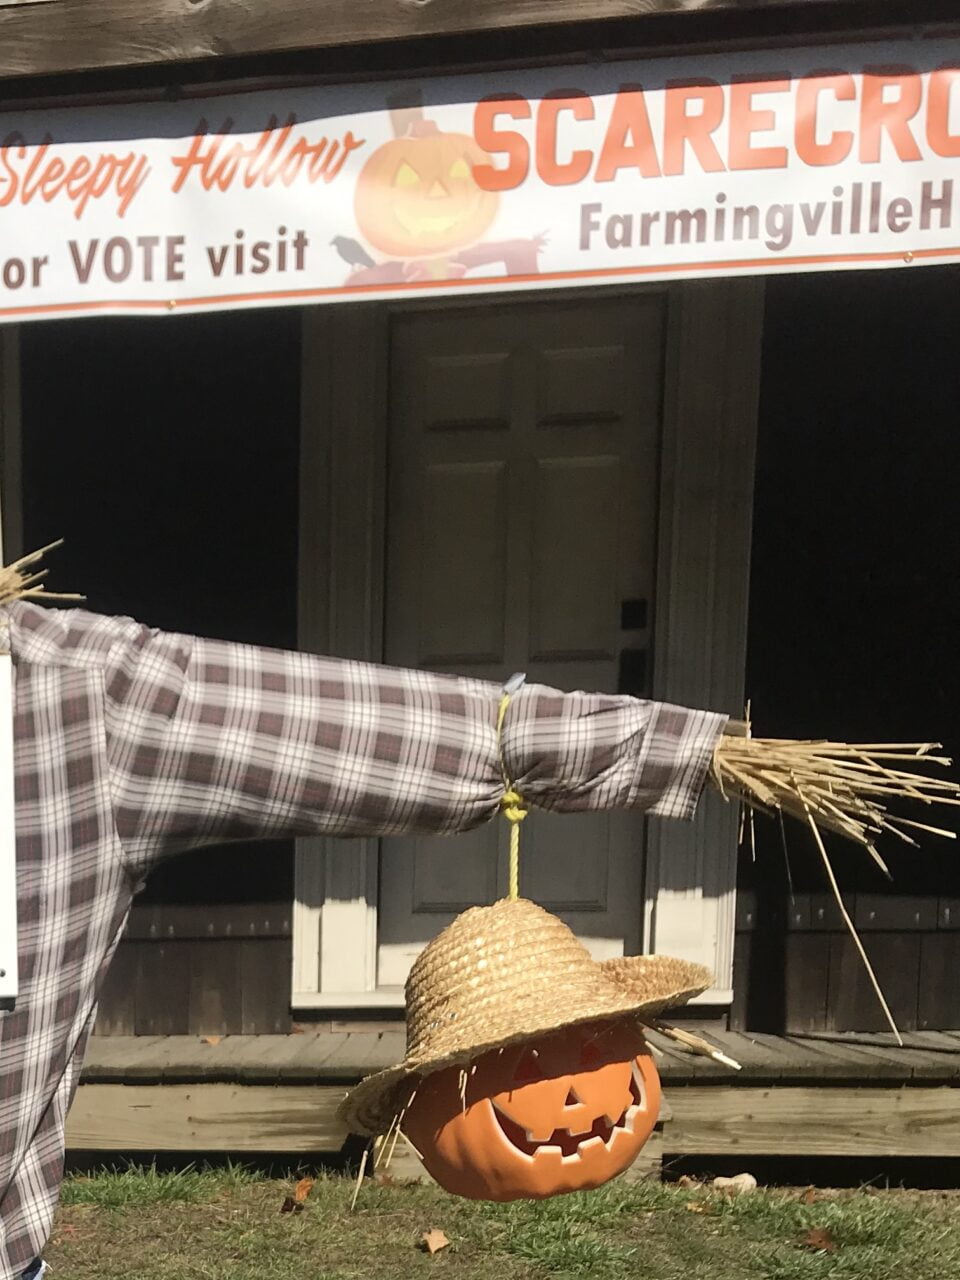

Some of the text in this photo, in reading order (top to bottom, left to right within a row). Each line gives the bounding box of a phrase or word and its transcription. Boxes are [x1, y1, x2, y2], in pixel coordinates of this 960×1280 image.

[171, 112, 367, 196] Hollow
[577, 179, 955, 253] FarmingvilleH
[2, 254, 50, 289] or
[68, 234, 186, 284] VOTE
[206, 228, 309, 277] visit
